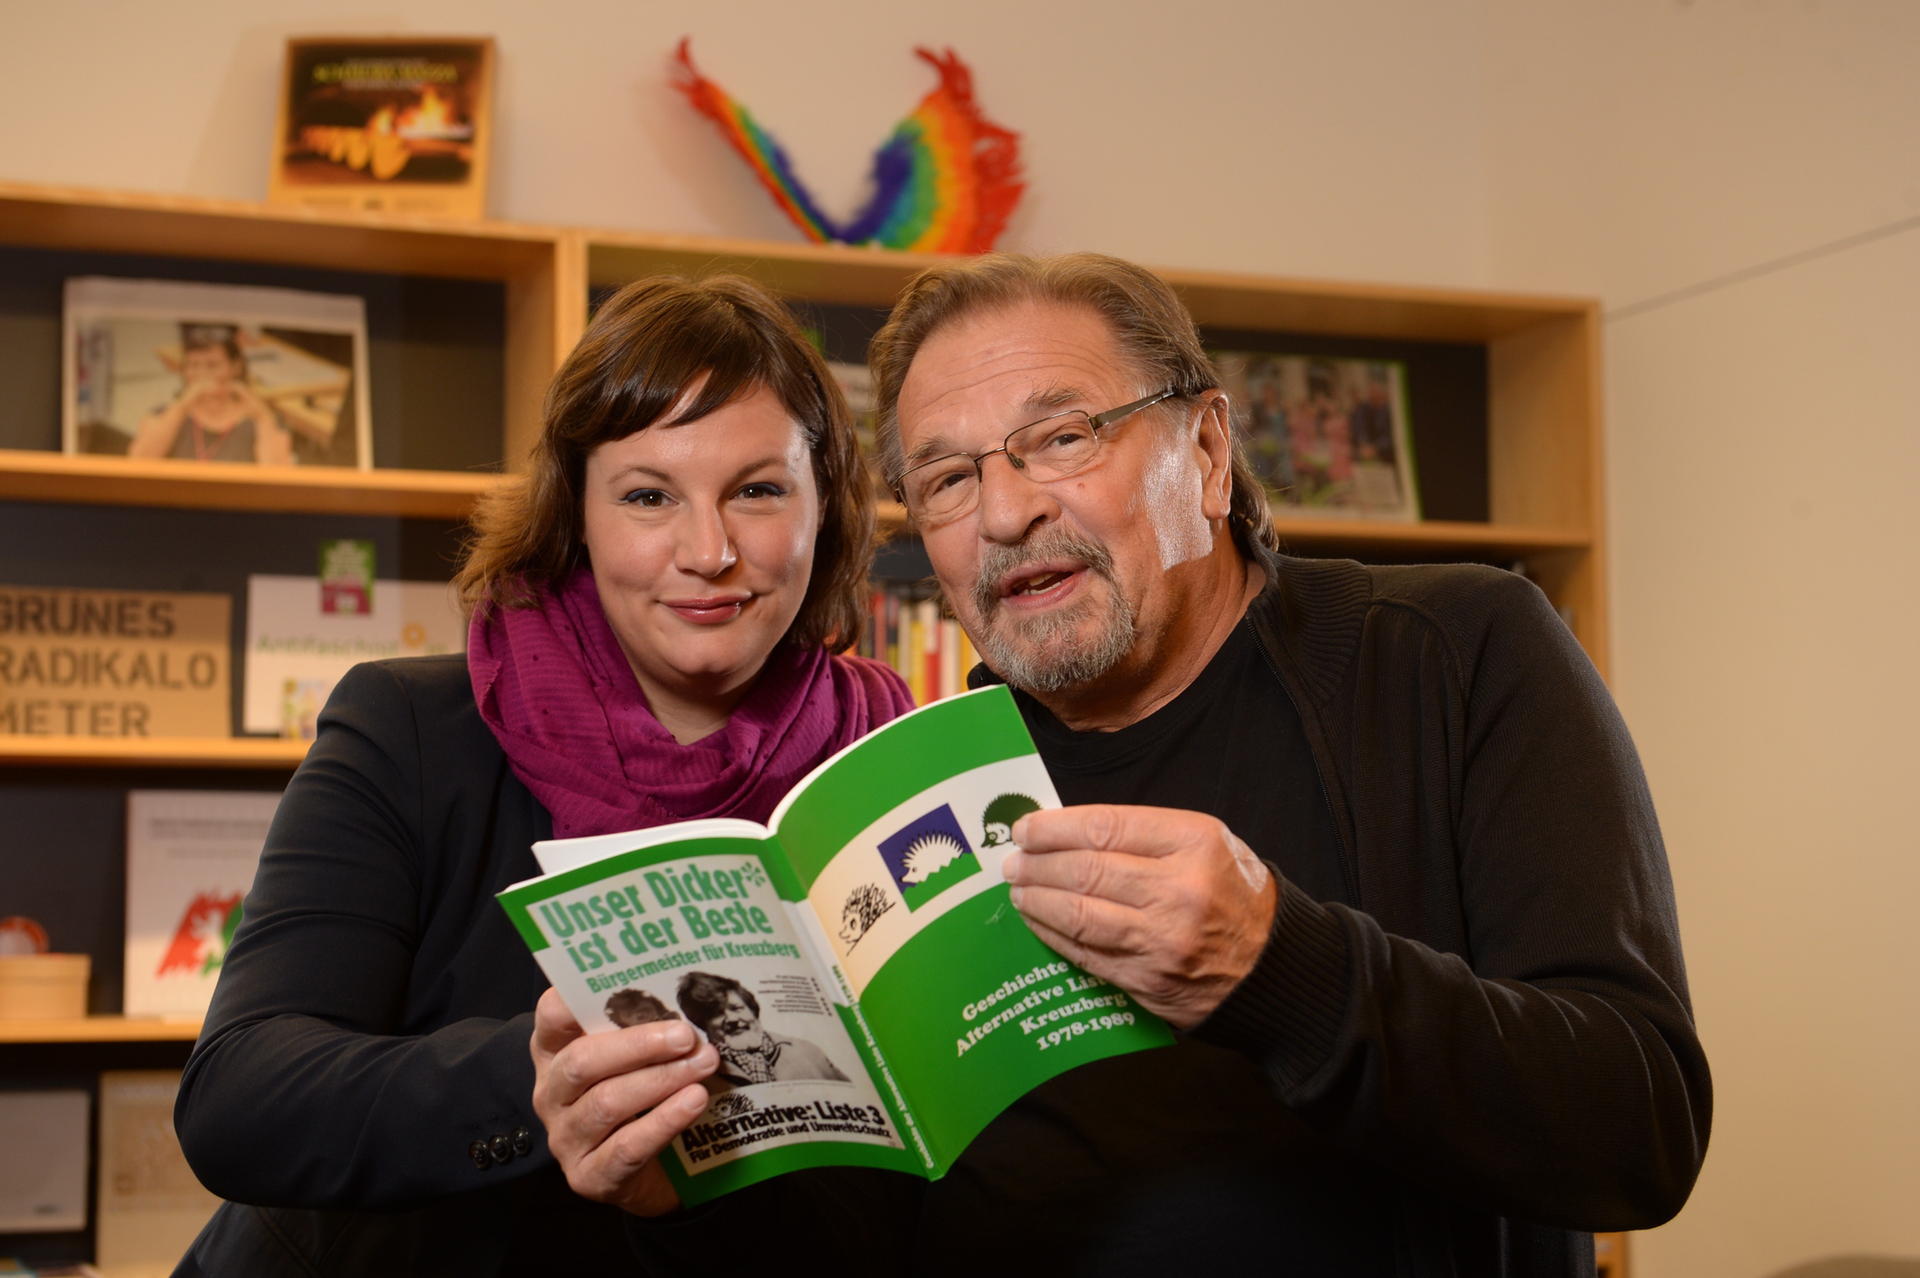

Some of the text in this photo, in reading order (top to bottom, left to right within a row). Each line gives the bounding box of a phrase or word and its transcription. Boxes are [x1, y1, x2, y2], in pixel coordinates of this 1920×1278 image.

[0, 645, 217, 690] RADIKALO
[540, 885, 645, 938] Unser
[562, 901, 774, 973] ist der Beste
[586, 940, 800, 993] Bürgermeister für Kreuzberg
[961, 961, 1069, 1021] Geschichte
[955, 984, 1064, 1057] Alternative
[1019, 993, 1128, 1034] Kreuzberg
[1036, 1011, 1136, 1050] 1978-1989
[682, 1100, 885, 1151] Alternative: Liste 3
[689, 1121, 892, 1164] Für Demokratie und Umweltschutz
